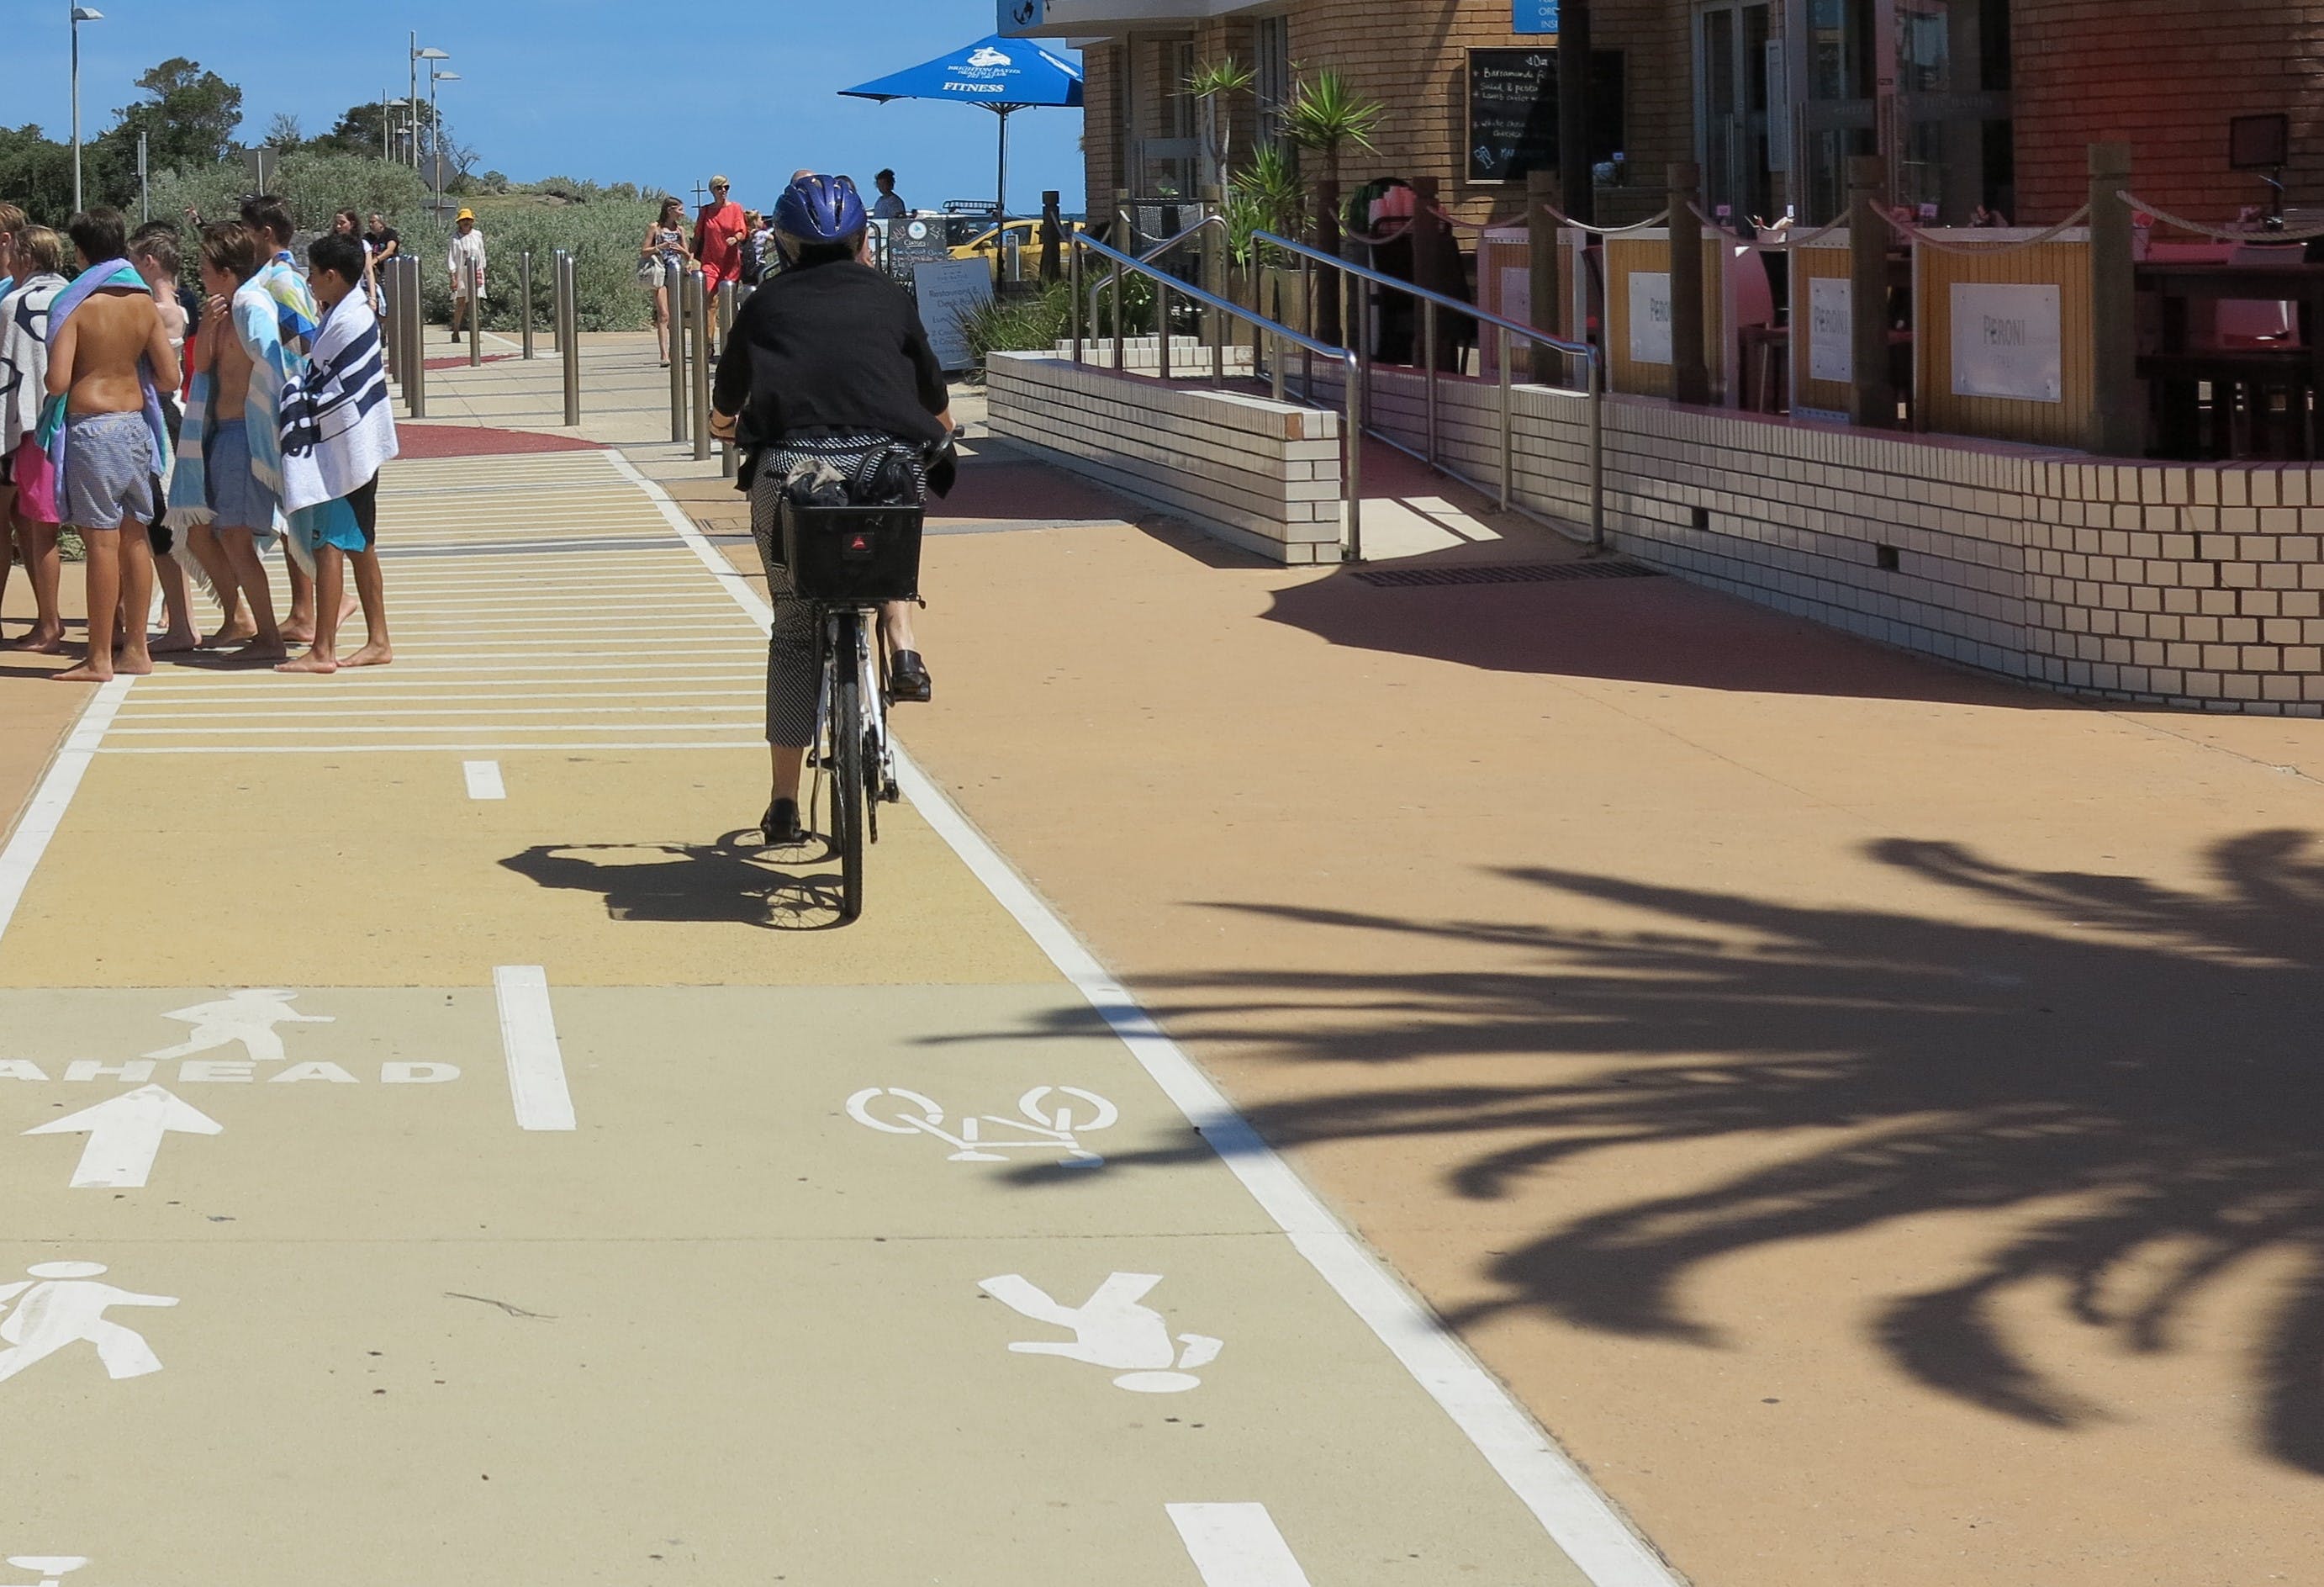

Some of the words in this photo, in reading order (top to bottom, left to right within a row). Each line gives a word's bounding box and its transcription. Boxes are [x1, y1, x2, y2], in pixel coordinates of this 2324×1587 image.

[943, 82, 1005, 93] FITNESS
[1983, 314, 2026, 346] PERONI
[0, 1060, 461, 1084] AHEAD
